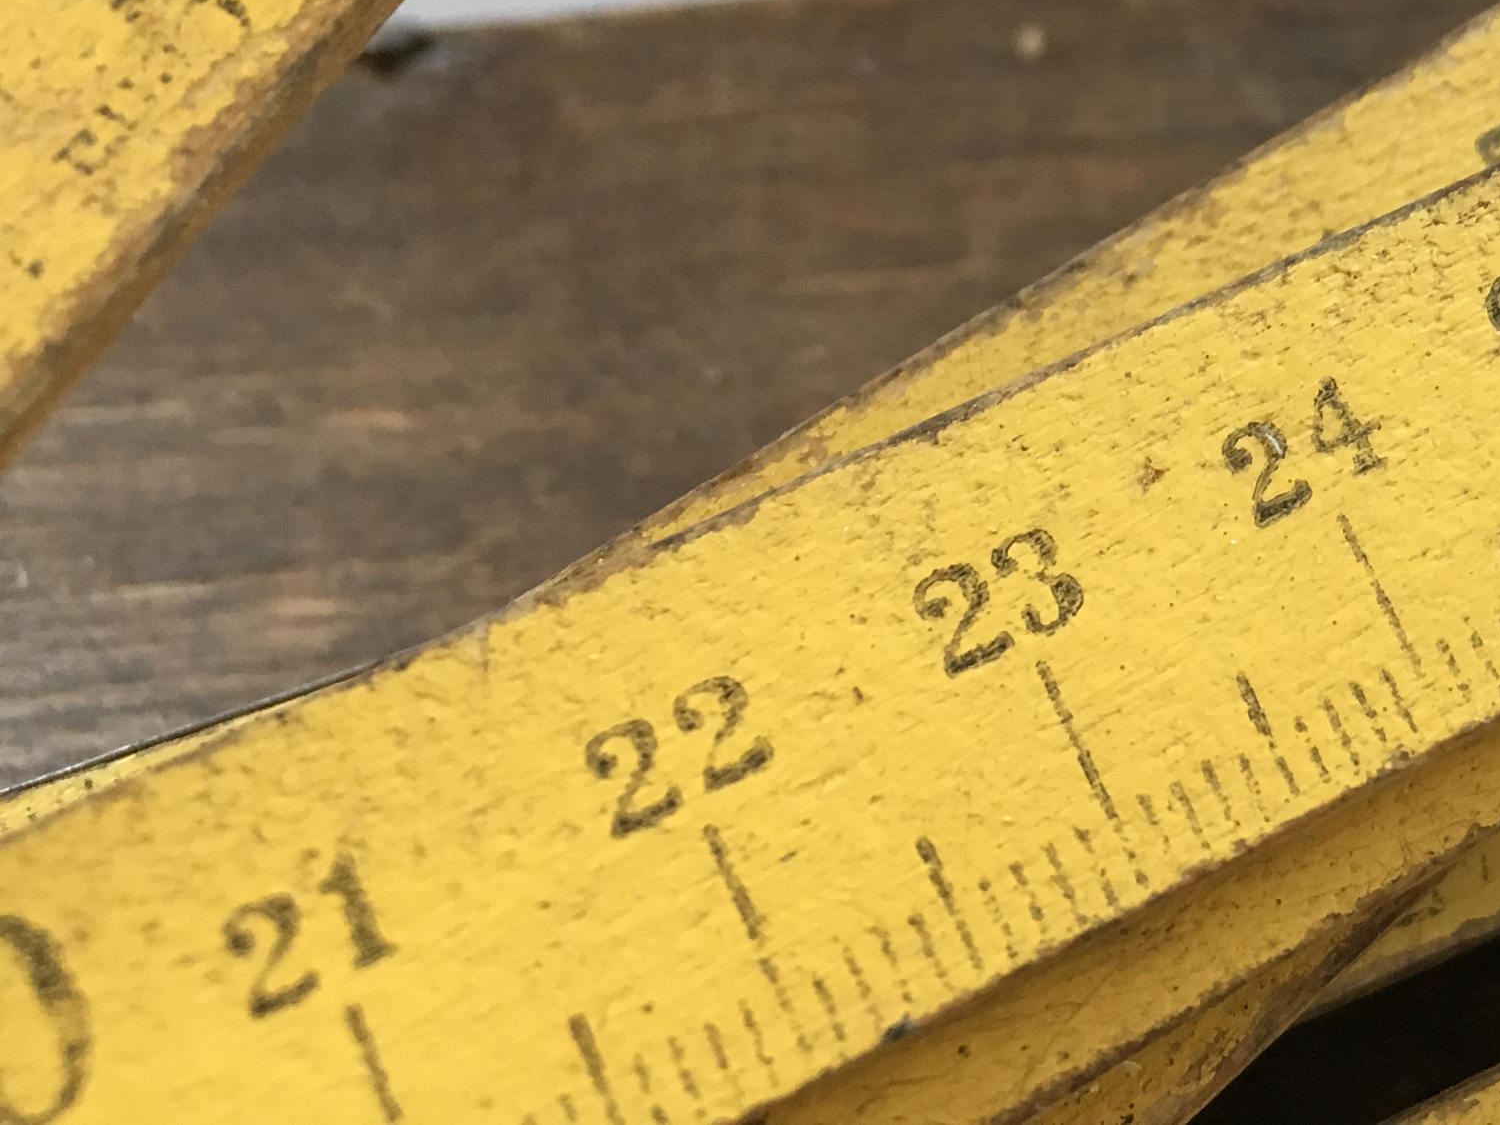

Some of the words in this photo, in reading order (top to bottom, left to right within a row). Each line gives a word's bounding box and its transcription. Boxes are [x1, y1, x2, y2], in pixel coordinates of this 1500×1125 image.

[1222, 376, 1389, 527] 24
[912, 528, 1085, 678] 23
[584, 675, 775, 839] 22
[220, 850, 398, 1020] 21
